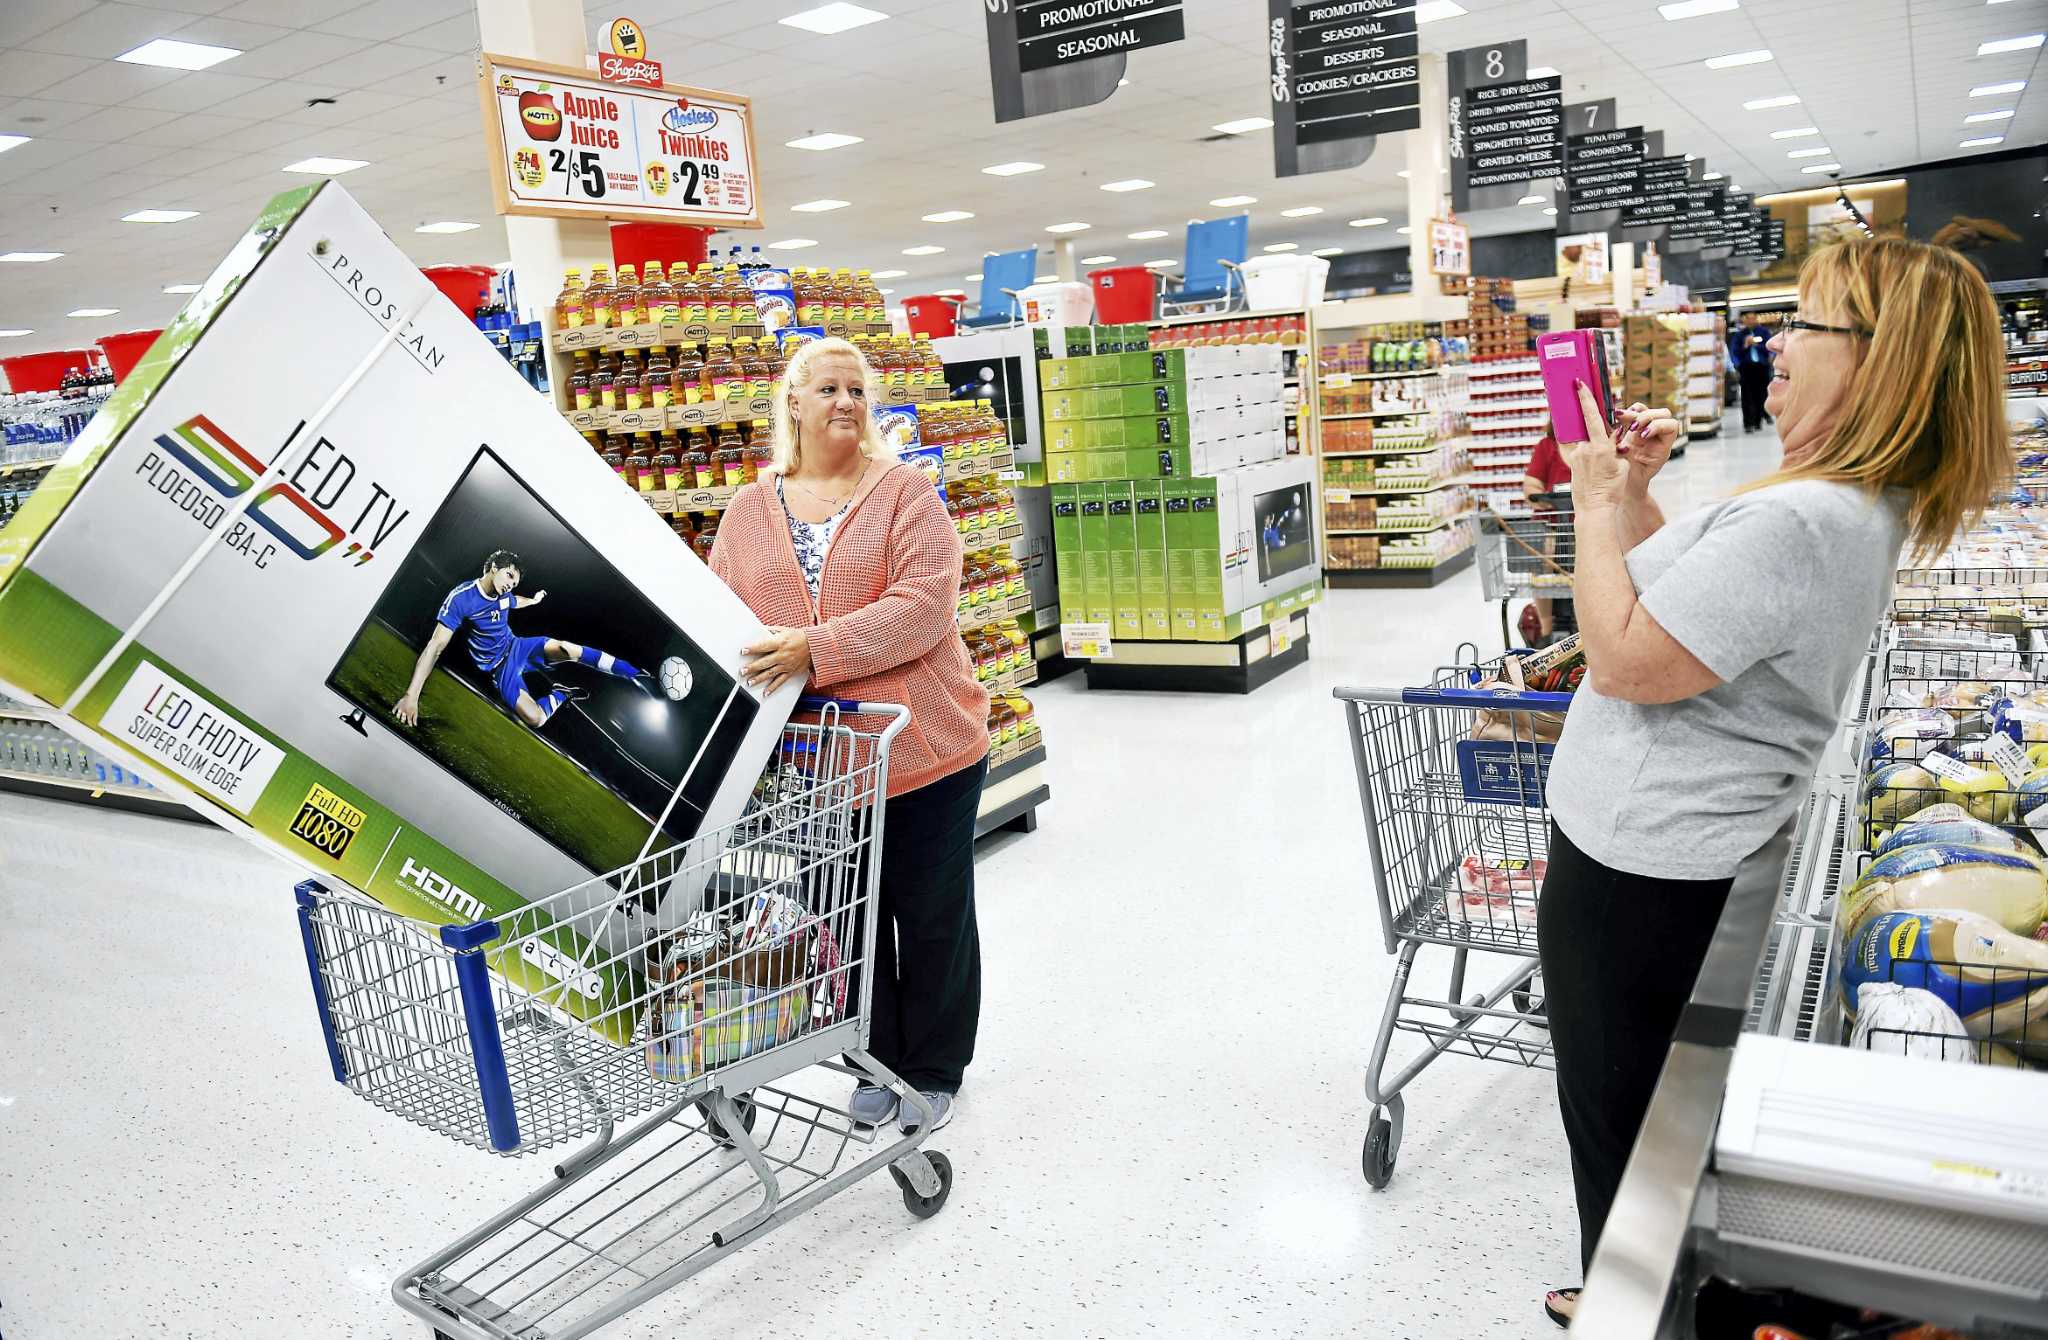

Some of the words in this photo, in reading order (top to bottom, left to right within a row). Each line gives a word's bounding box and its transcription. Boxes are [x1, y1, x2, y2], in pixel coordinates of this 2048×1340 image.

[1057, 29, 1141, 59] SEASONAL
[1321, 22, 1386, 43] SEASONAL
[1324, 46, 1385, 67] DESSERTS
[1485, 49, 1504, 78] 8
[603, 58, 660, 82] ShopRite
[1296, 65, 1417, 95] COOKIES/CRACKERS
[1519, 81, 1549, 94] BEANS
[563, 91, 619, 121] Apple
[670, 106, 714, 129] Hostess
[1584, 106, 1599, 129] 7
[570, 121, 620, 150] Juice
[1470, 122, 1509, 135] CANNED
[1510, 115, 1560, 129] TOMATOES
[658, 129, 729, 161] Twinkies
[1474, 137, 1523, 152] SPAGHETTI
[1524, 132, 1555, 145] SAUCE
[1578, 143, 1633, 158] CONDIMENTS
[1478, 155, 1514, 168] GRATED
[1515, 150, 1553, 163] CHEESE
[1470, 171, 1532, 186] INTERNATIONAL
[1532, 167, 1561, 178] FOODS
[1576, 173, 1612, 185] PREPARED
[1613, 170, 1638, 181] FOODS
[1572, 202, 1601, 213] CANNED
[1601, 196, 1645, 209] VEGETABLES
[350, 481, 410, 551] TV
[144, 684, 193, 730] LED
[188, 712, 262, 773] FHDTV
[128, 715, 175, 756] SUPER
[173, 742, 209, 775] SLIM
[204, 762, 242, 796] EDGE
[309, 788, 337, 812] Full
[341, 804, 363, 829] HD
[294, 806, 349, 854] 1080
[399, 856, 486, 921] HDMI
